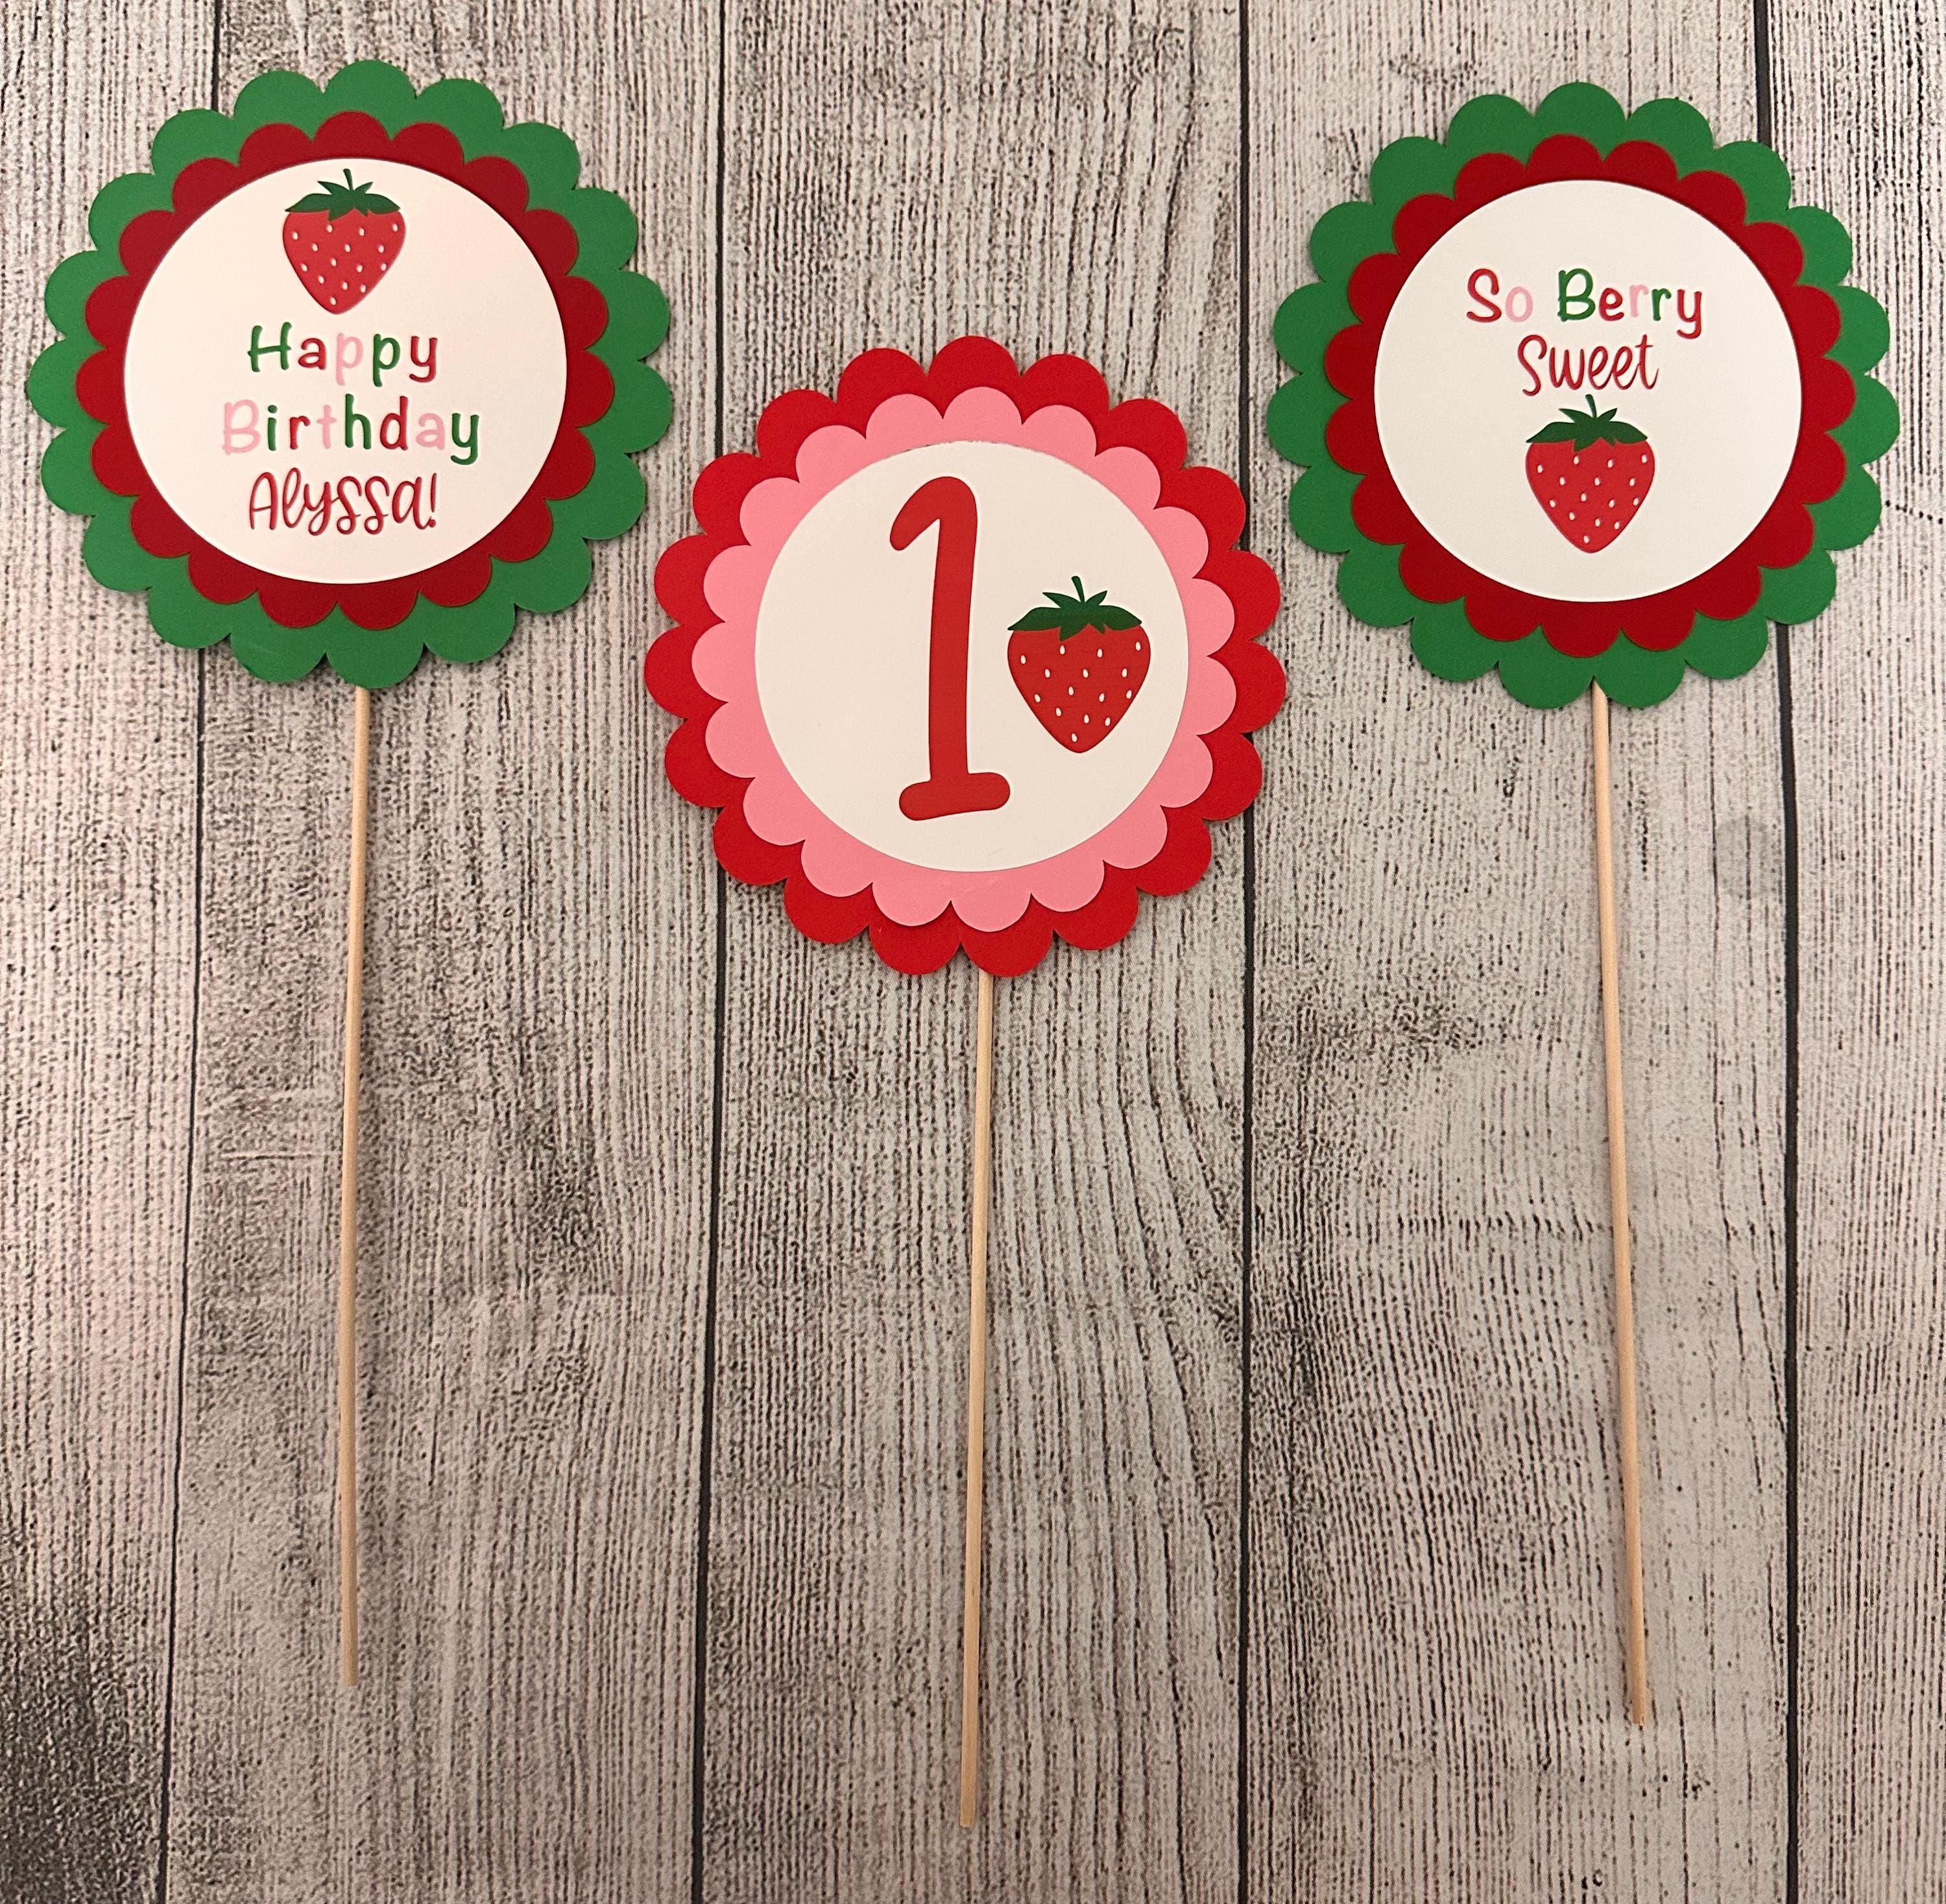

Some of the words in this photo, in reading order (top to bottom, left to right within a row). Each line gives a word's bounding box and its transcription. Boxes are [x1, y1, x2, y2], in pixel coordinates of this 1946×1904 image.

[1466, 267, 1533, 323] So
[1557, 267, 1703, 339] Berry
[247, 322, 438, 388] Happy
[1517, 334, 1659, 397] Sweet
[222, 393, 480, 466] Birthday
[248, 467, 438, 536] Alyssa!
[889, 476, 1011, 821] 1
